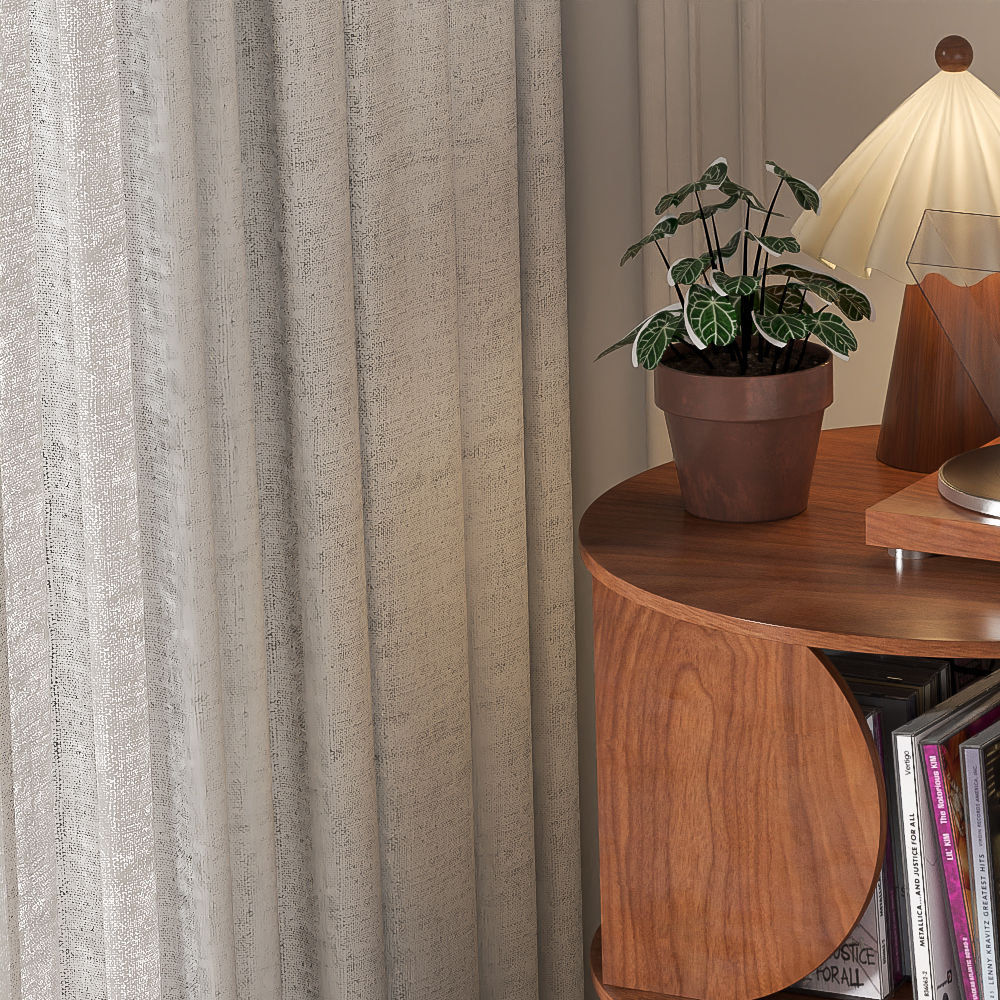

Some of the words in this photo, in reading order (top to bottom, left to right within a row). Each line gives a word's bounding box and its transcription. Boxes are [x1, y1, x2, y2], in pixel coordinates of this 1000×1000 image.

[902, 751, 912, 777] Vertigo
[928, 755, 938, 771] KIM
[931, 771, 945, 810] Notorious
[938, 811, 948, 826] The
[974, 803, 982, 829] RECORDS
[941, 833, 951, 849] KIM
[911, 846, 919, 877] JUSTICE
[944, 848, 954, 863] LIL'
[977, 854, 985, 874] HITS
[979, 877, 989, 917] GREATEST
[983, 920, 992, 955] KRAVITZ
[833, 942, 875, 966] USTICE
[816, 966, 840, 984] FOR
[841, 967, 865, 988] ALL
[985, 957, 994, 985] LENNY
